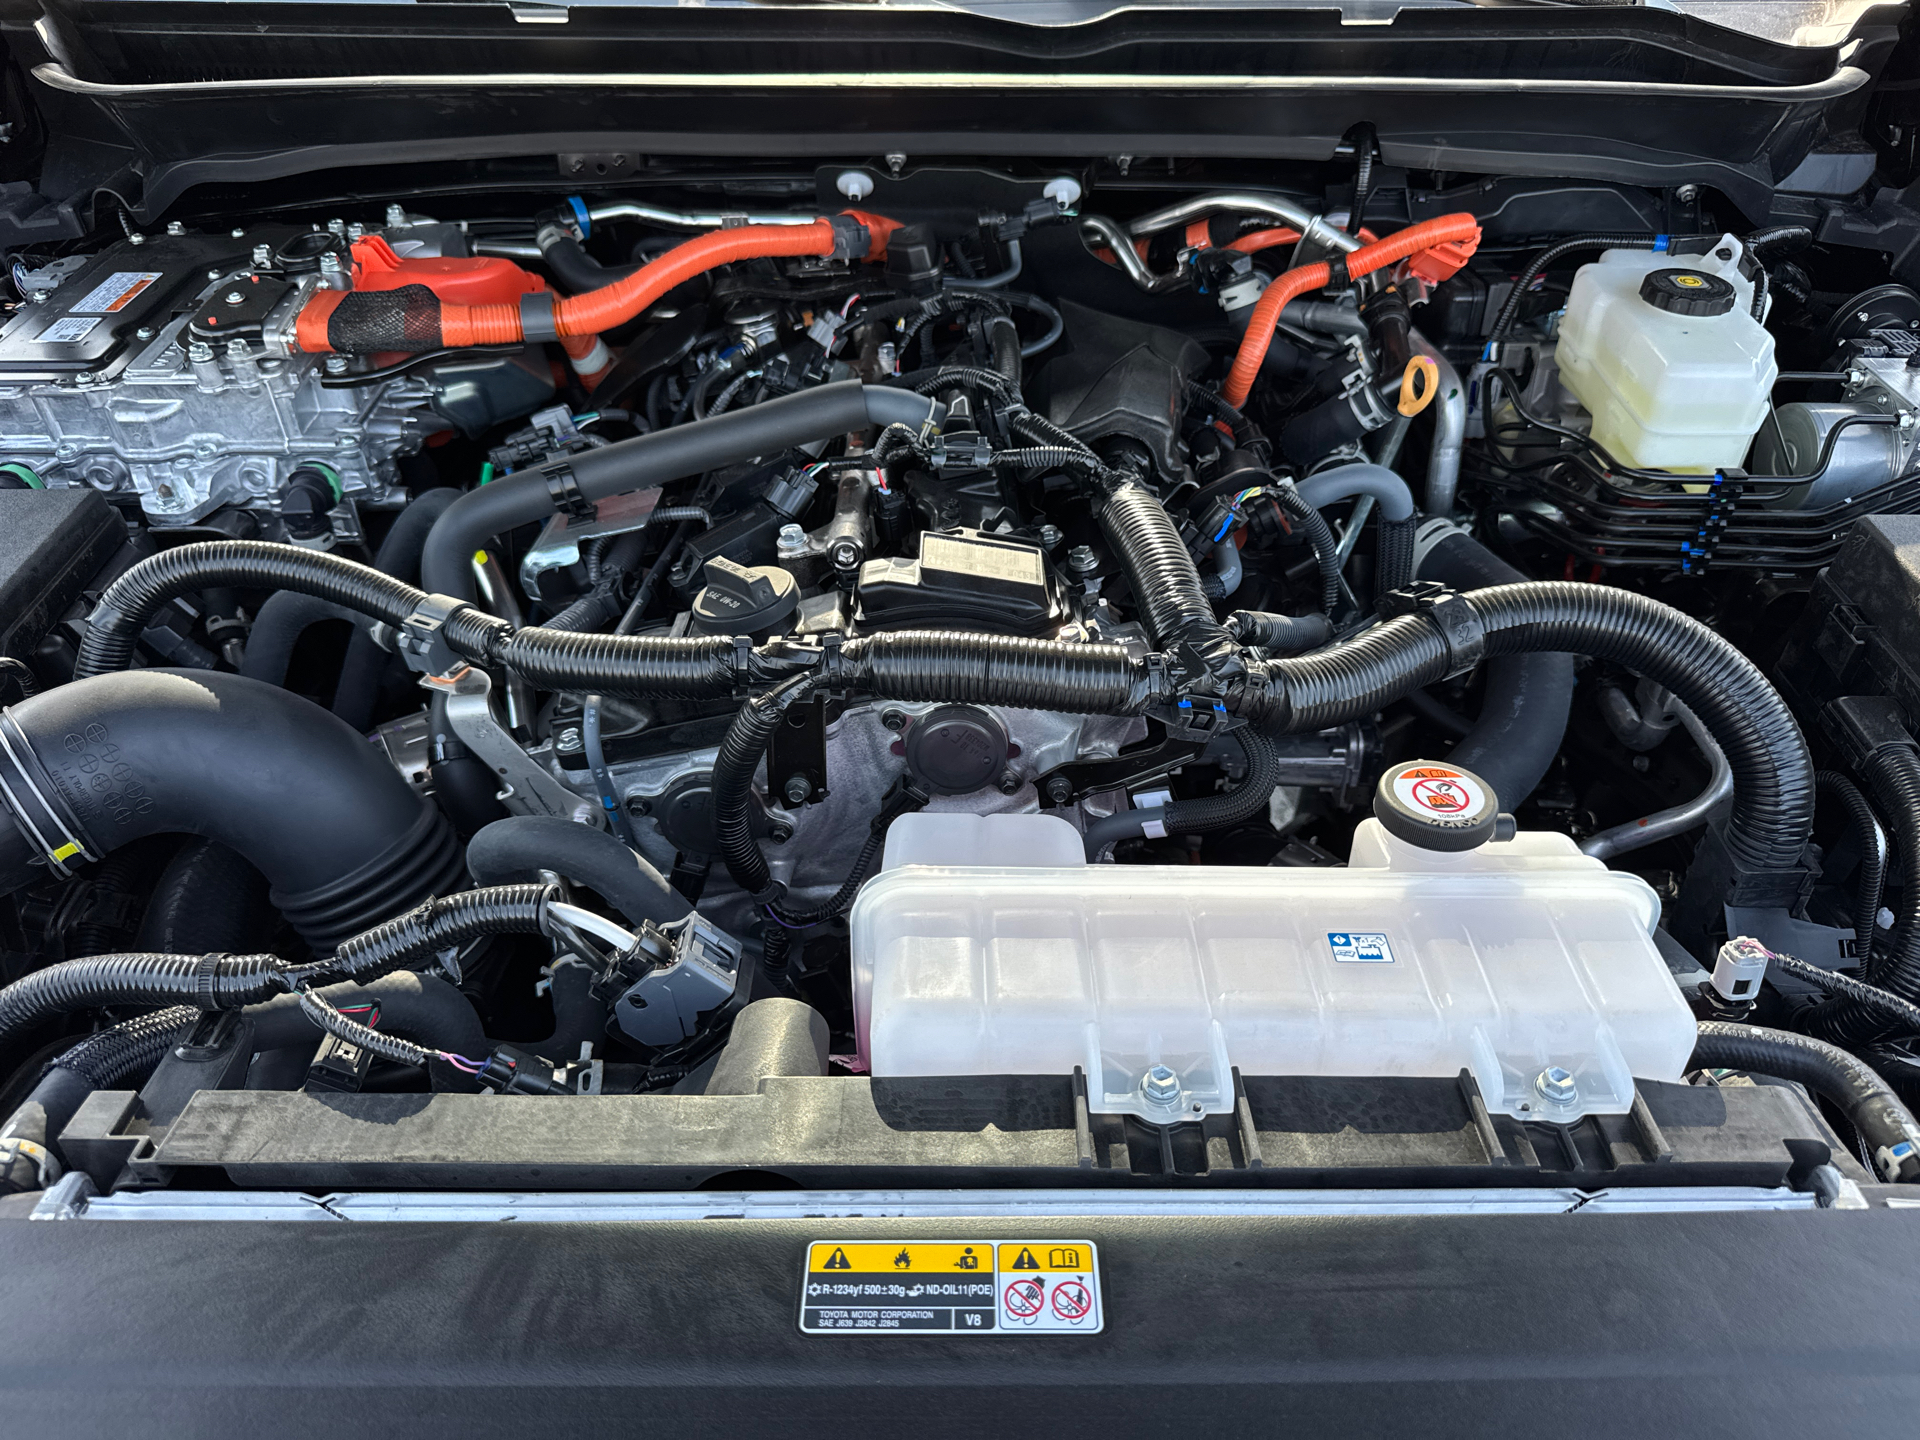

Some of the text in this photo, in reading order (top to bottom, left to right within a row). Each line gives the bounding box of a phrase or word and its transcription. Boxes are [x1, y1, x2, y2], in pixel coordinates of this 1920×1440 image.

[706, 591, 741, 609] SAE 0W-20
[1427, 816, 1480, 828] DENSO
[822, 1284, 994, 1298] R-1234yf 500±30g ND-OIL11(POE)
[820, 1310, 934, 1319] TOYOTA MOTOR CORPORATION
[964, 1313, 983, 1326] V8
[818, 1319, 835, 1328] SAE
[836, 1319, 854, 1328] J639
[855, 1319, 877, 1328] J2842
